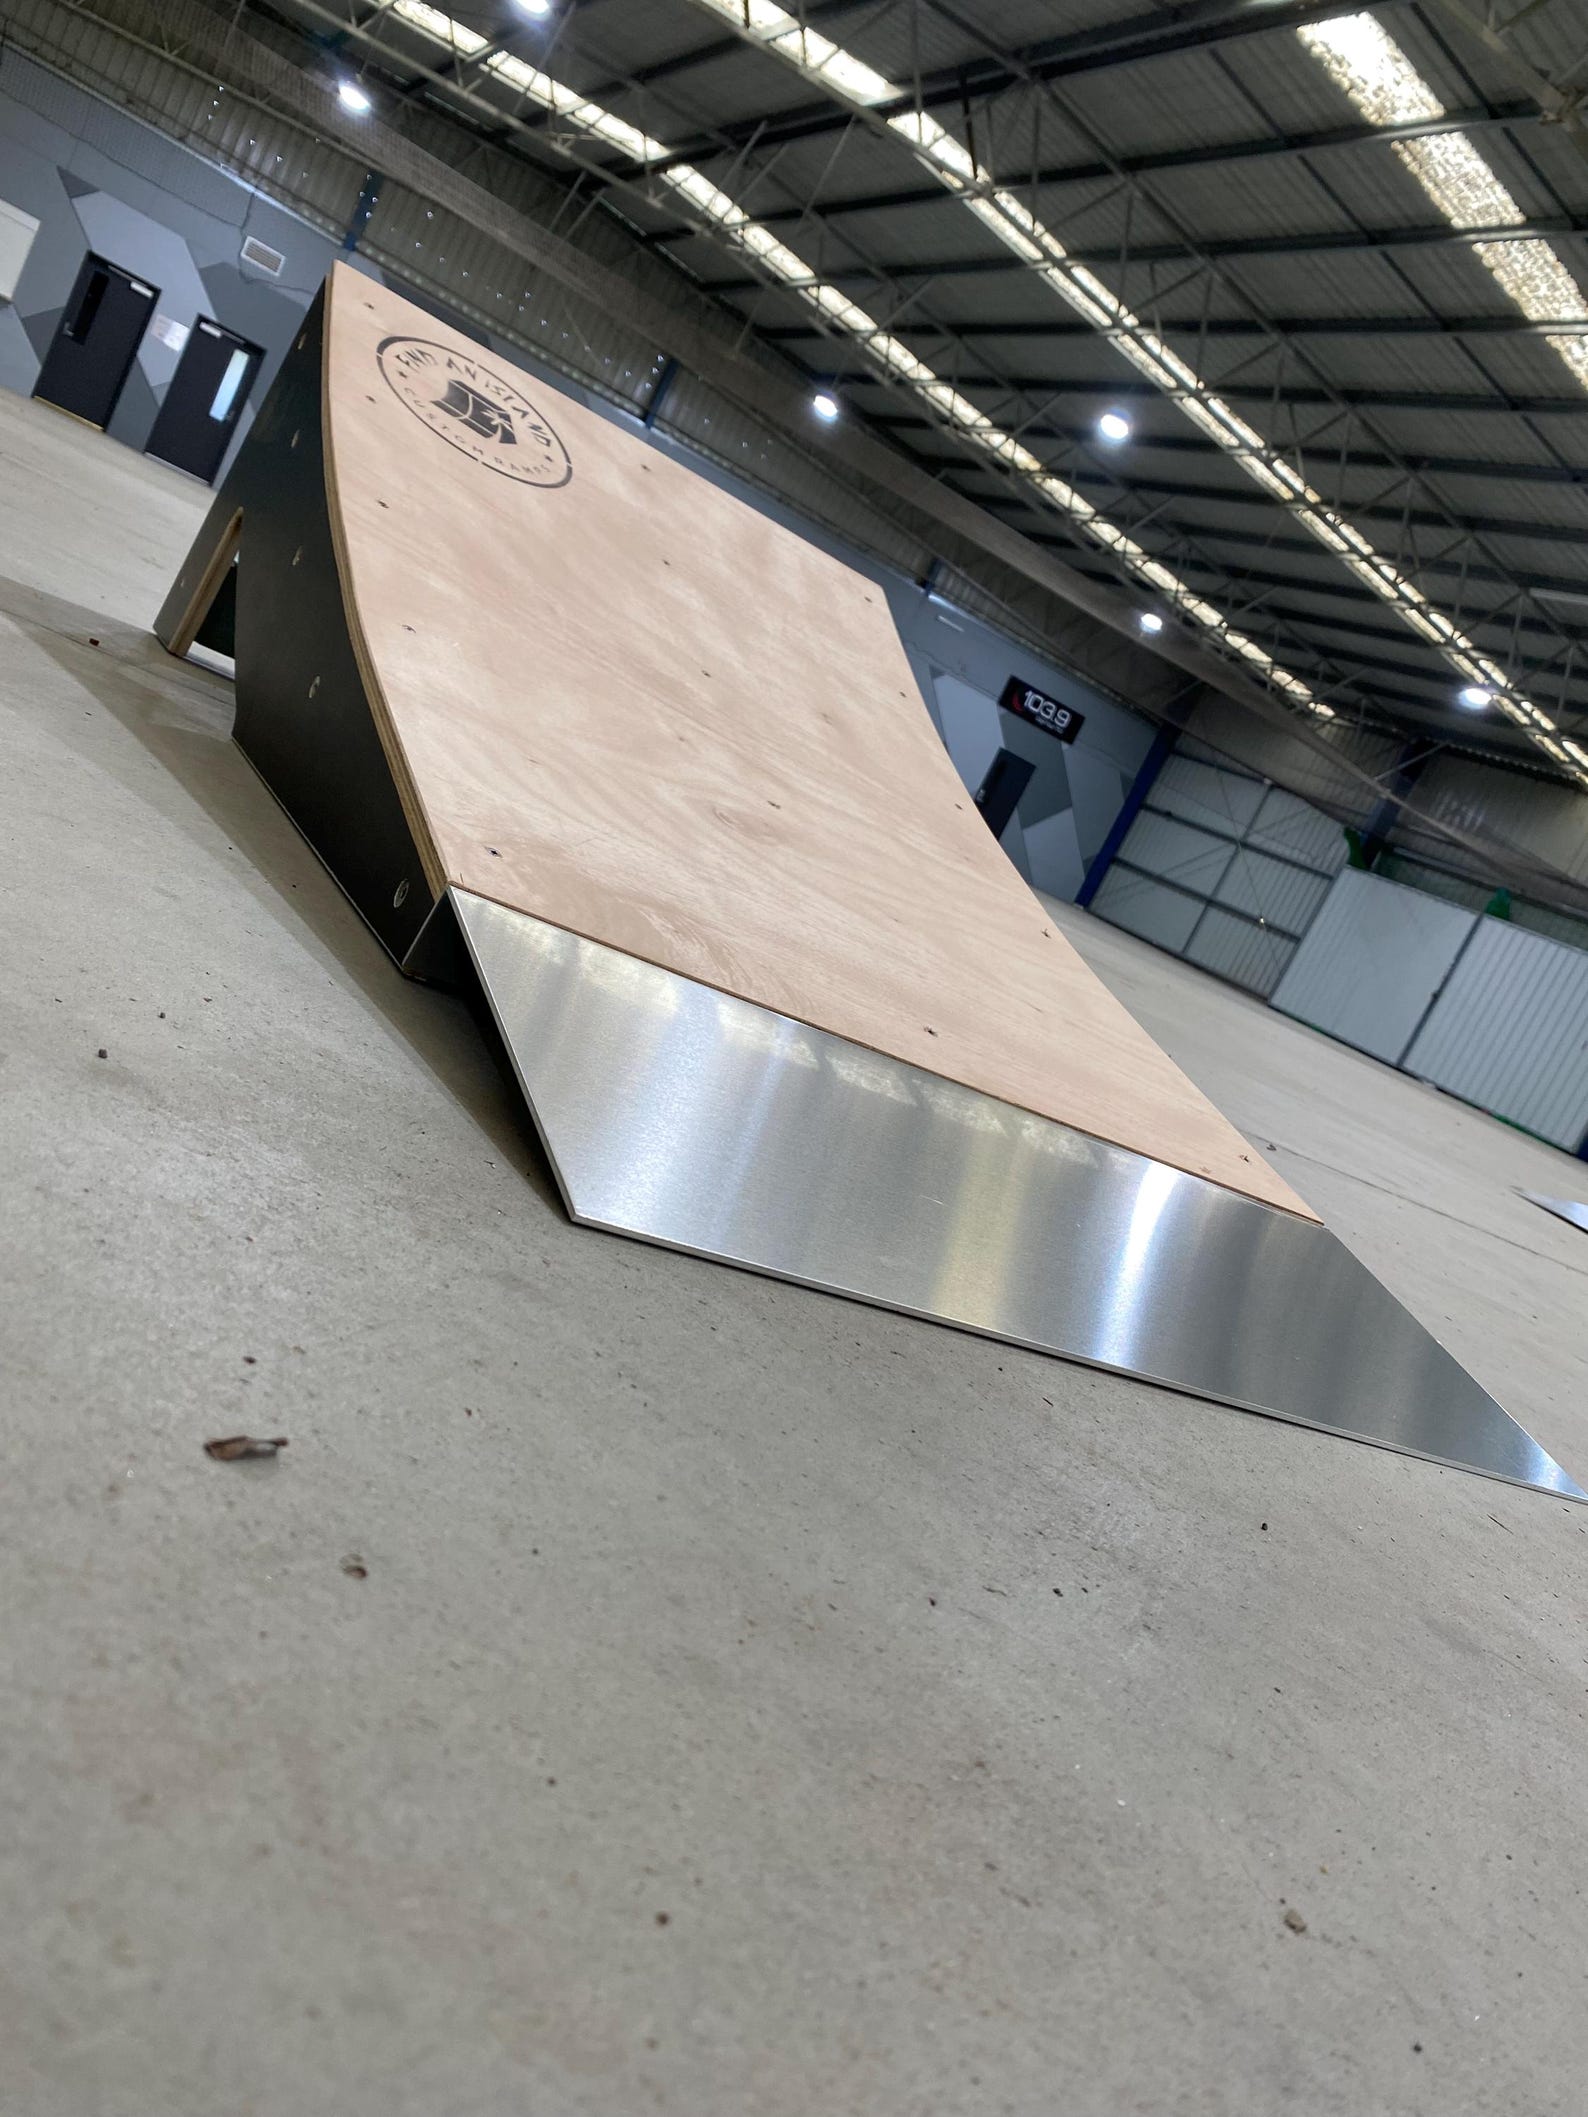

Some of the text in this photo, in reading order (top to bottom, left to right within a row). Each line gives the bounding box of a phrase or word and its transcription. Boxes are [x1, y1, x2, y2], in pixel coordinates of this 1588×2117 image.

[404, 387, 551, 475] CUSTOM RAMPS
[446, 357, 477, 380] AN
[485, 380, 551, 447] ISLAND
[1024, 690, 1071, 728] 103.9
